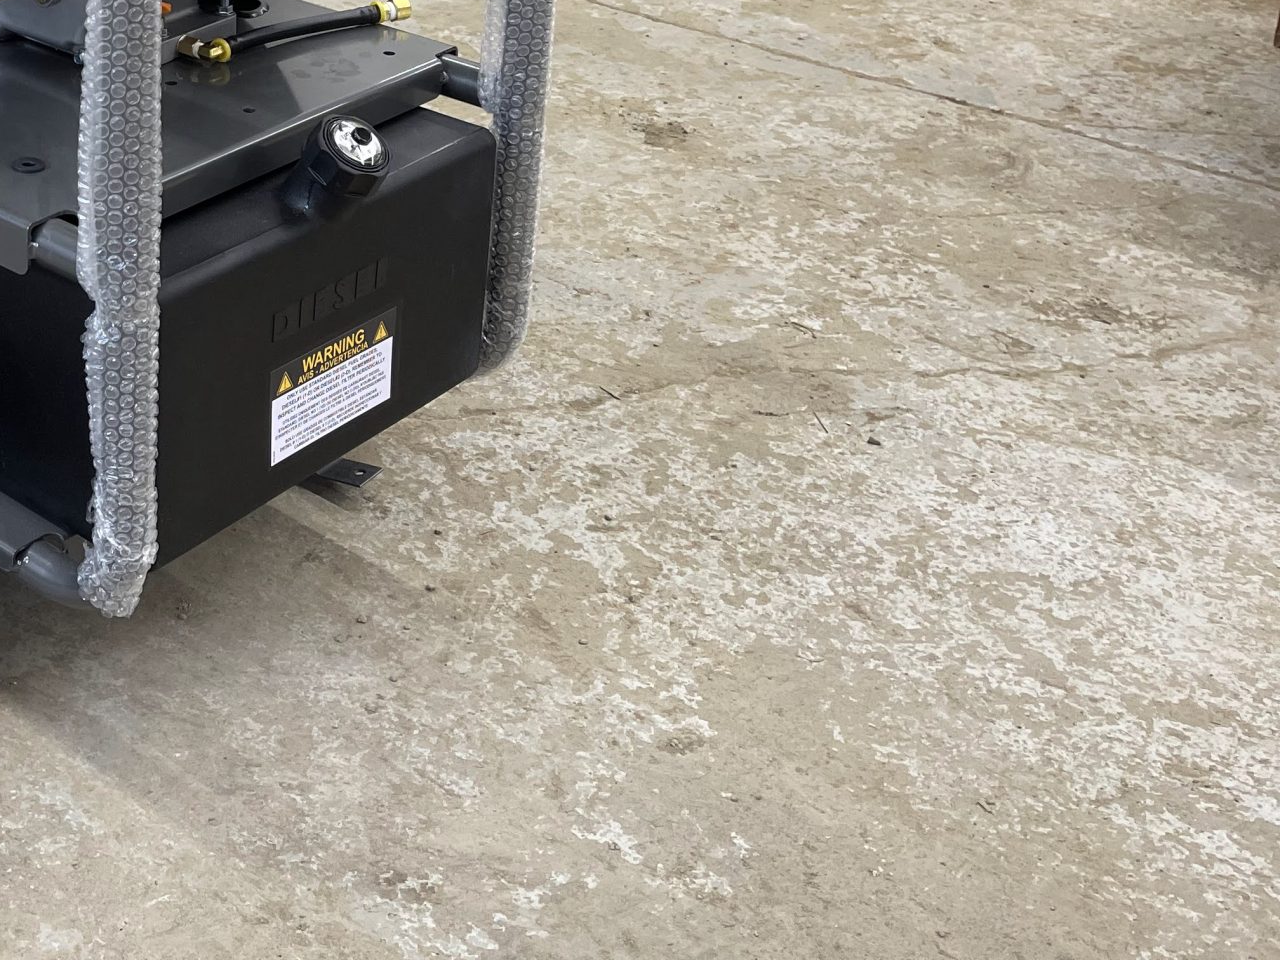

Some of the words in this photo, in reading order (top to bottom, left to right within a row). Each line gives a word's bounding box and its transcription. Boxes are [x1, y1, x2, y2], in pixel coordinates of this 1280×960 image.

[298, 370, 314, 385] AVIS
[319, 342, 369, 373] ADVERTENCIA
[302, 329, 365, 372] WARNING
[353, 355, 375, 371] REMEMBER
[278, 406, 295, 419] INSPECT
[298, 400, 306, 409] AND
[308, 390, 324, 403] CHANGE
[342, 374, 355, 384] FILTER
[357, 357, 385, 376] PERIODICALLY
[310, 372, 331, 387] STANDARD
[333, 364, 346, 374] DIESEL
[349, 358, 358, 366] FUEL
